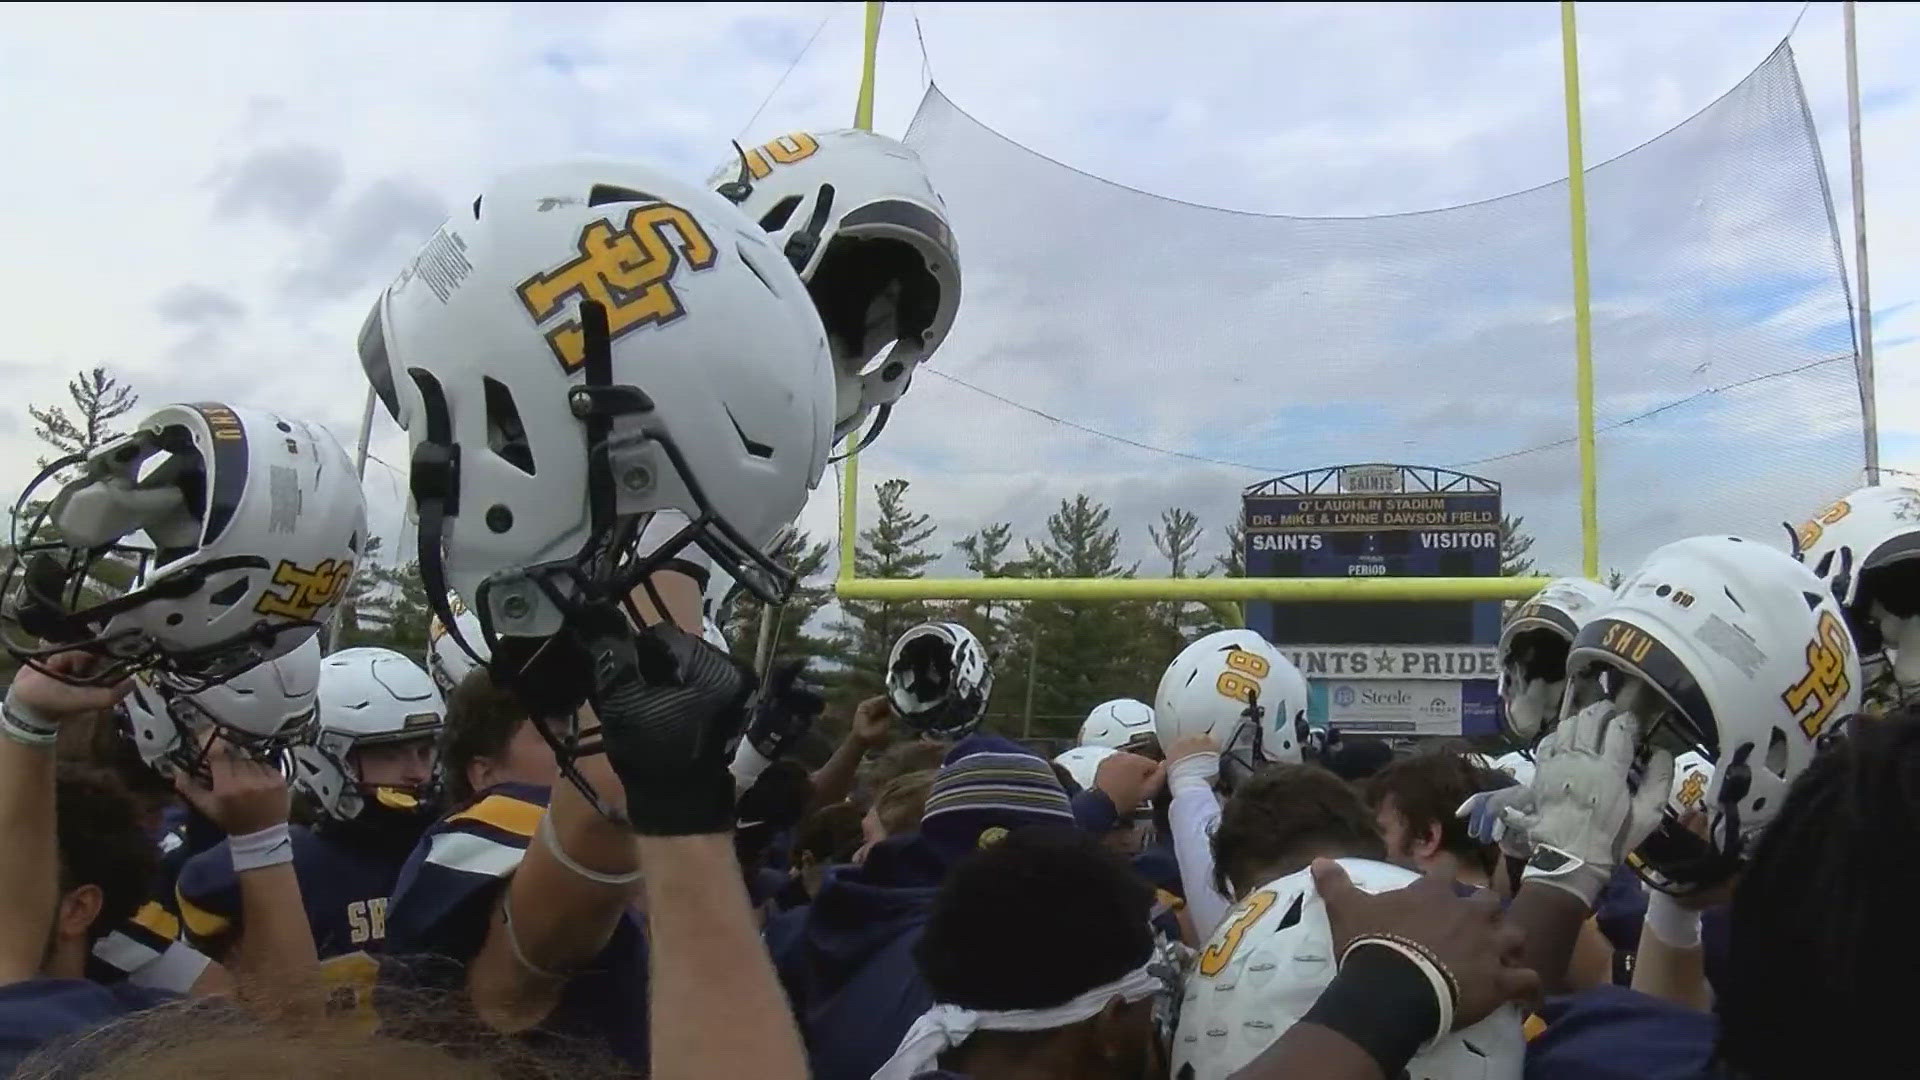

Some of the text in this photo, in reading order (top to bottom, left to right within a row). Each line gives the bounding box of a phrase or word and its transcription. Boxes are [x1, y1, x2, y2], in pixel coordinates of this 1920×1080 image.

[1349, 476, 1393, 491] SAINTS
[1386, 498, 1445, 511] STADIUM
[1253, 510, 1493, 526] DR. MIKE & LYNNE DAWSON FIELD
[1252, 531, 1497, 551] SAINTS VISITOR
[1347, 564, 1387, 576] PERIOD
[1602, 622, 1654, 663] SHU
[1401, 650, 1497, 675] PRIDE
[1360, 688, 1412, 706] Steele
